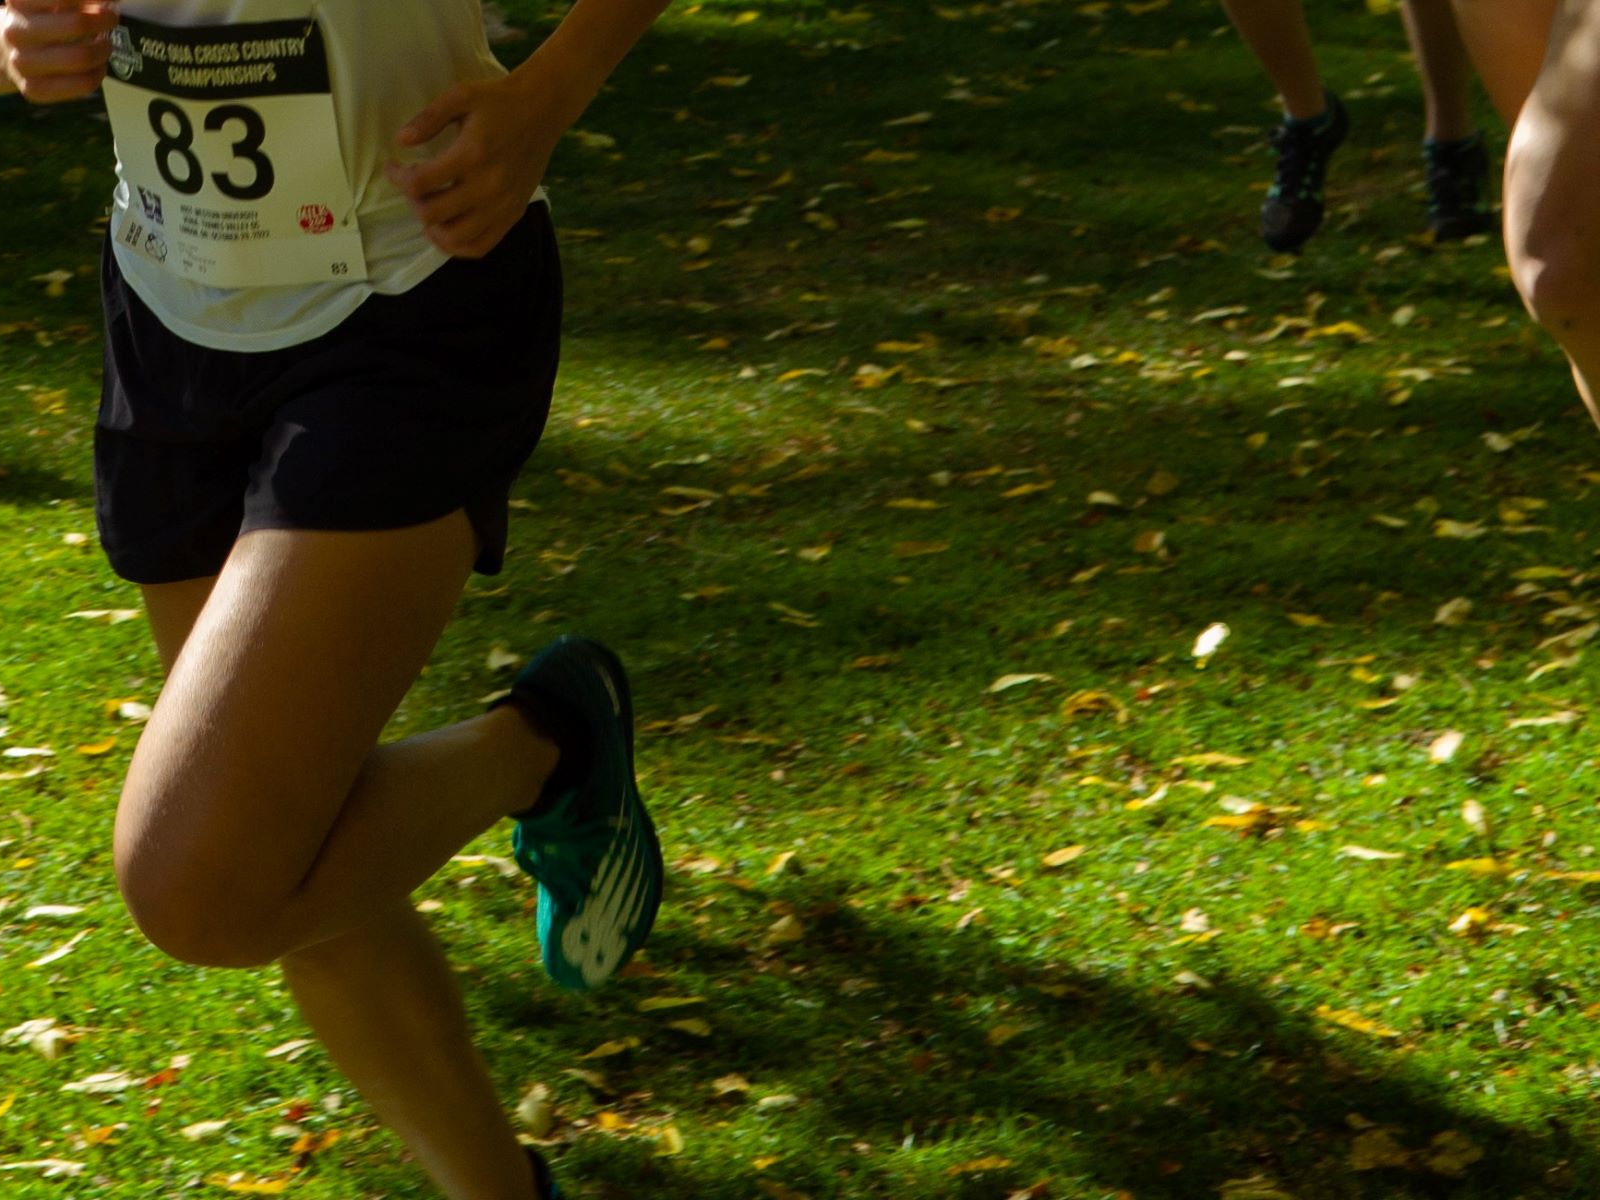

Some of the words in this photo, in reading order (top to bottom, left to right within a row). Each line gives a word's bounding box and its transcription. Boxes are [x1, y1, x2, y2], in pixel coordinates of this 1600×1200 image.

[140, 36, 167, 62] 2022
[194, 42, 241, 65] CROSS
[241, 37, 306, 61] COUNTRY
[167, 62, 277, 87] CHAMPIONSHIPS
[147, 98, 275, 201] 83
[331, 262, 348, 275] 83
